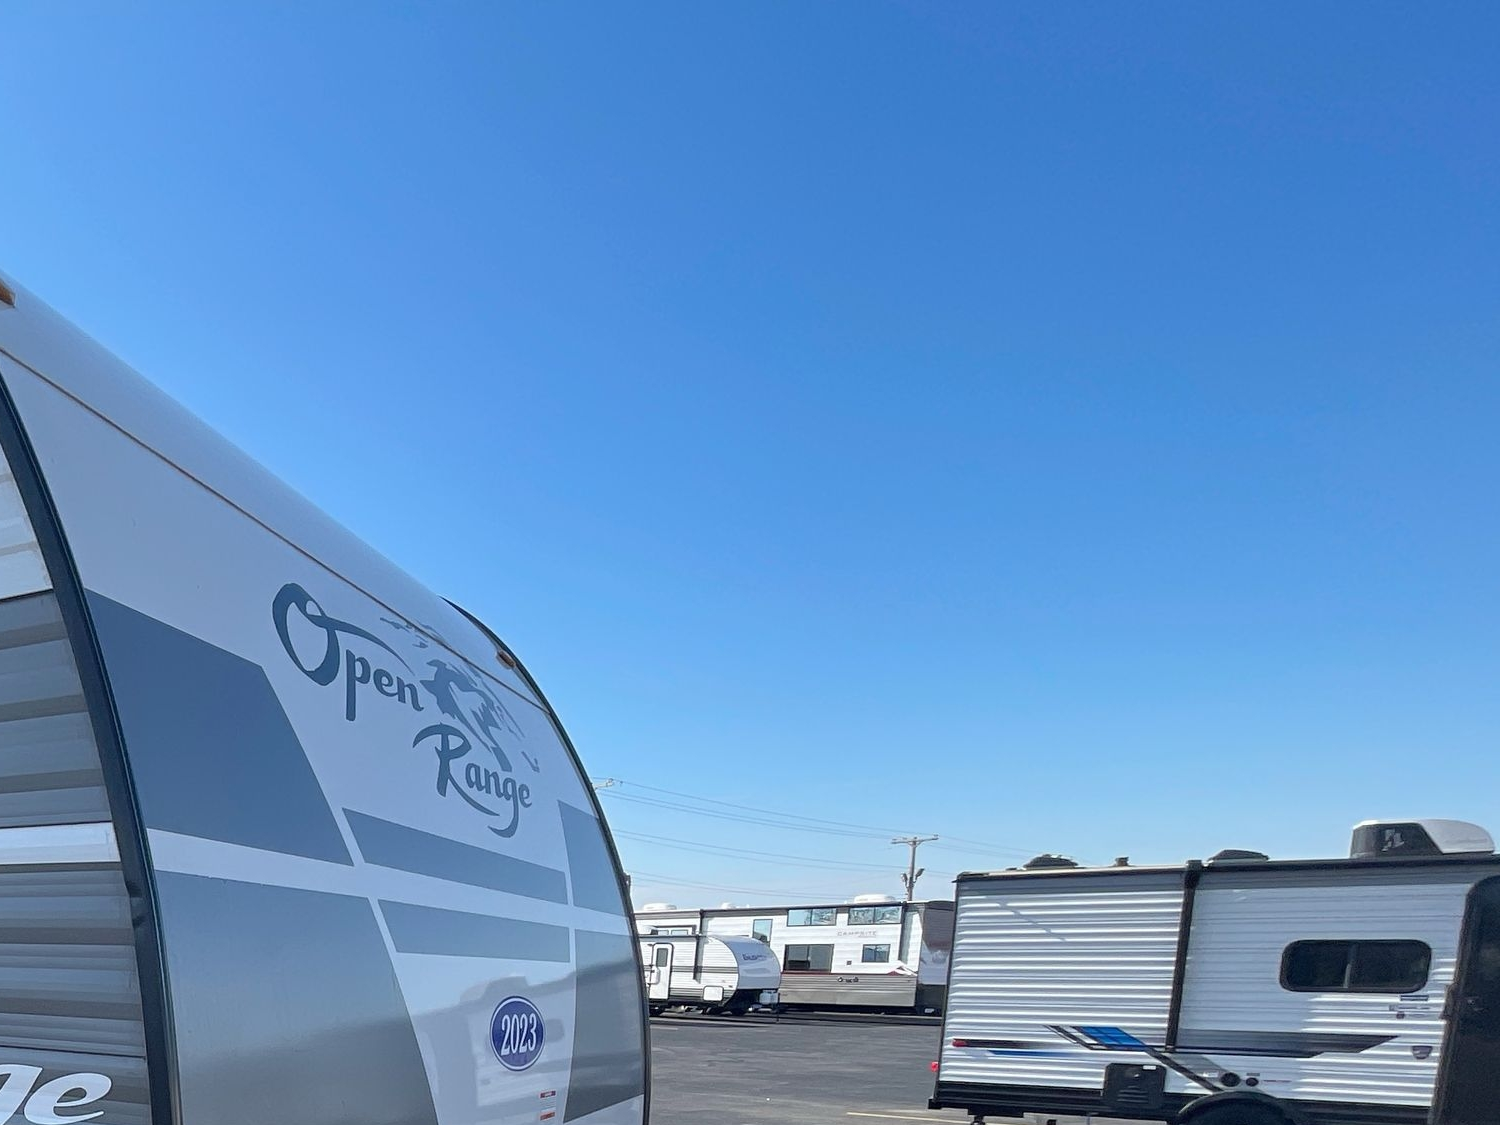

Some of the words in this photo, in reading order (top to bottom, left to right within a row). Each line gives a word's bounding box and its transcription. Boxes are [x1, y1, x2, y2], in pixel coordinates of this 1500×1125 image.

[272, 583, 424, 721] Open
[412, 722, 532, 838] Range
[501, 1013, 537, 1056] 2023
